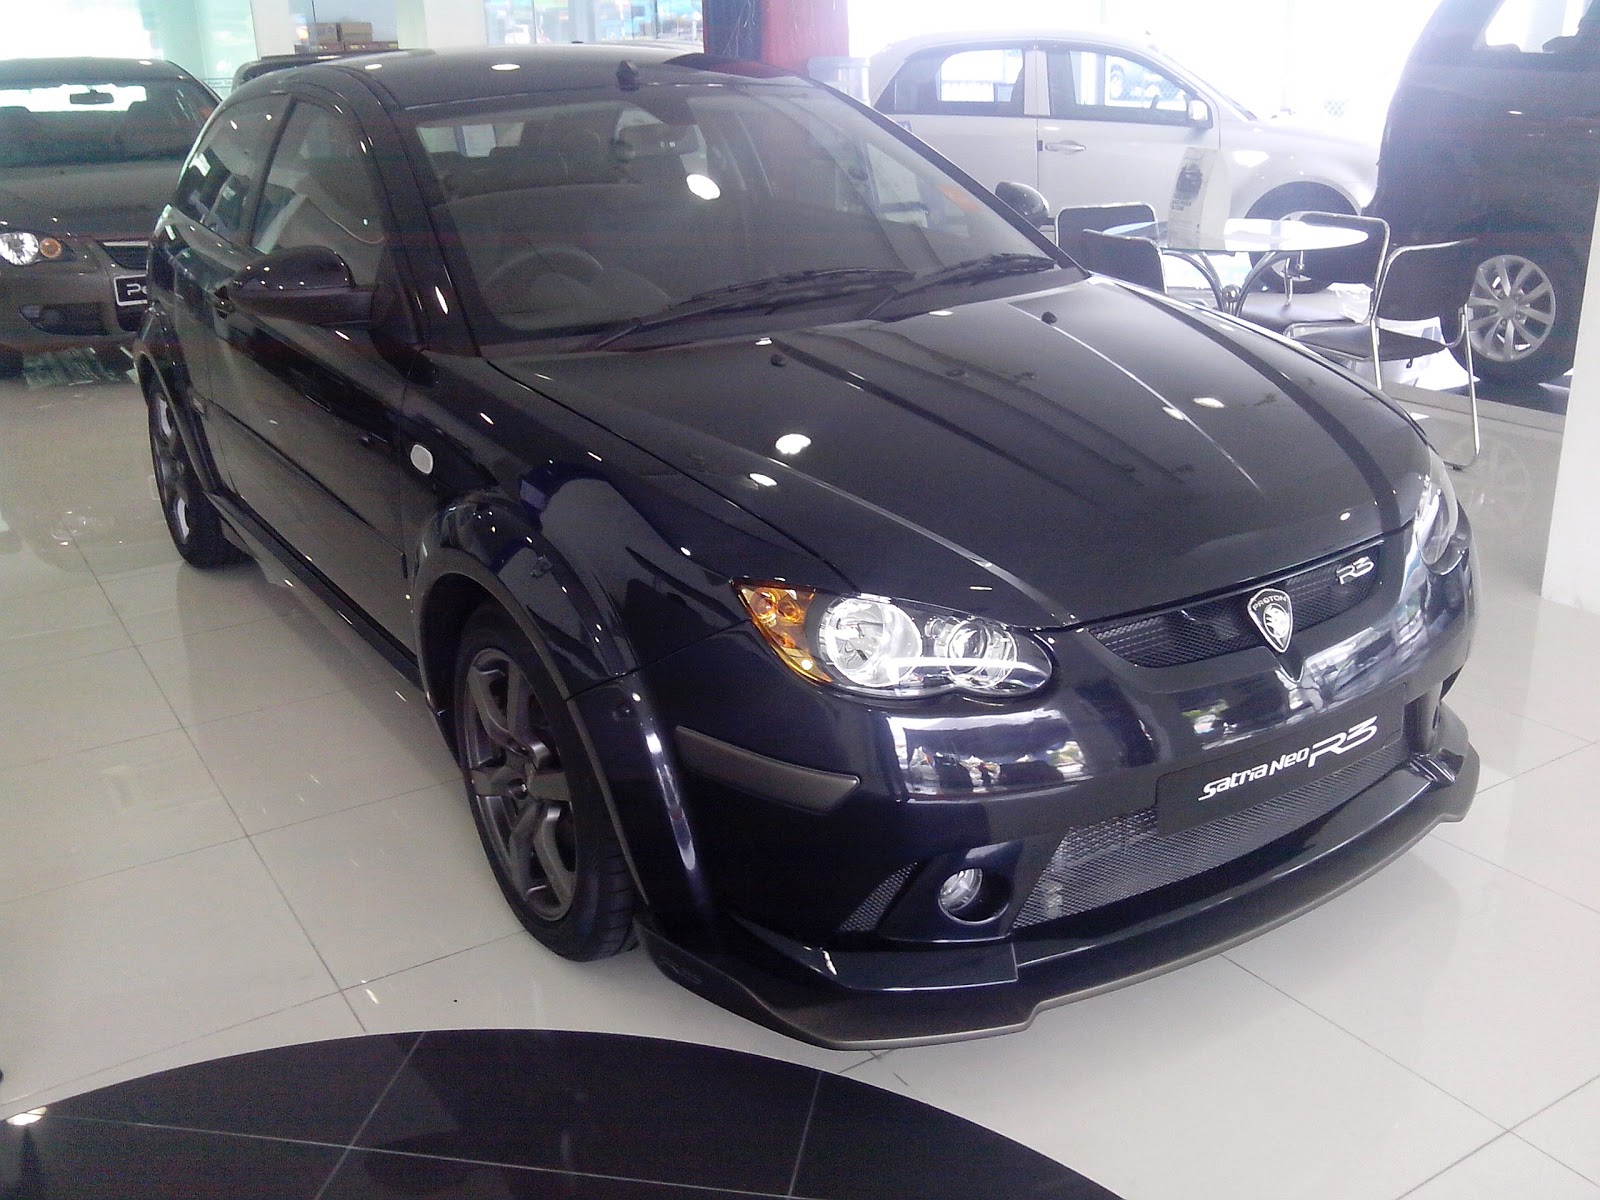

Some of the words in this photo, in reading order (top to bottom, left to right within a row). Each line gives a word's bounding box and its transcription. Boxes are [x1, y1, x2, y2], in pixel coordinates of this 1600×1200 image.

[1336, 556, 1375, 585] R3
[1252, 594, 1287, 611] PROTON
[1198, 763, 1268, 801] Satria
[1307, 715, 1378, 768] R3
